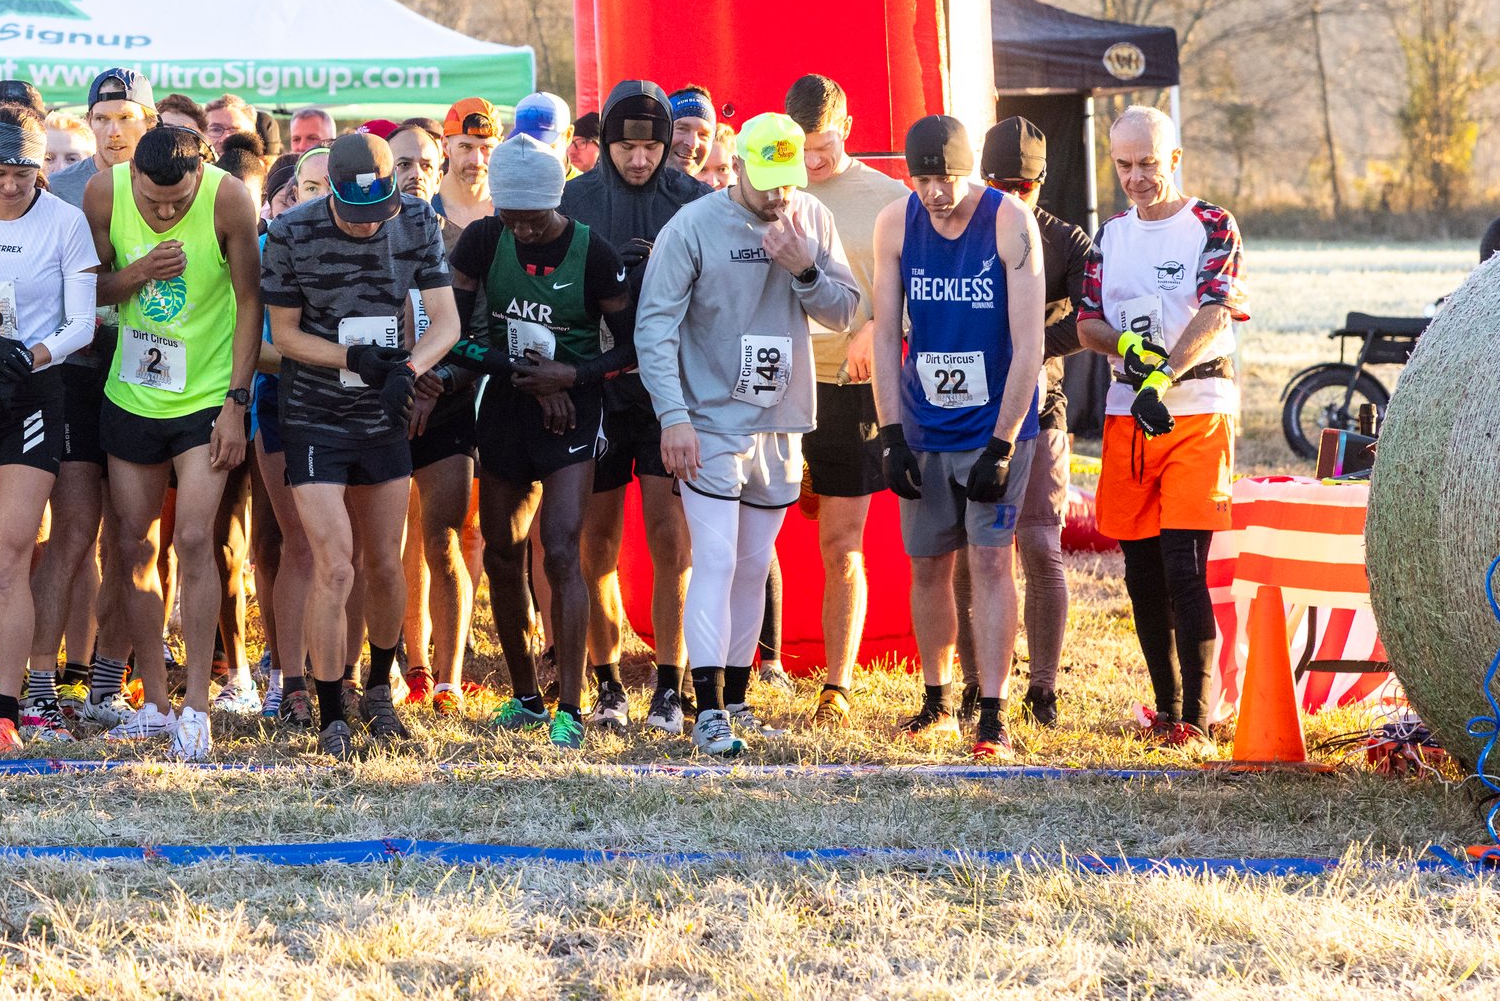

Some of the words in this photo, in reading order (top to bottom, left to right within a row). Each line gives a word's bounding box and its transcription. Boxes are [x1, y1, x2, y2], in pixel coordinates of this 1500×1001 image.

[911, 268, 925, 276] TEAM
[910, 277, 994, 302] RECKLESS
[506, 297, 553, 324] AKR
[132, 329, 149, 342] Dirt
[151, 333, 179, 349] Circus
[385, 327, 396, 346] Dirt
[510, 327, 518, 356] Circus
[147, 347, 162, 375] 2
[741, 344, 753, 376] Circus
[753, 347, 781, 395] 148
[926, 353, 941, 364] Dirt
[943, 354, 975, 364] Circus
[736, 377, 750, 394] Dirt
[934, 369, 968, 395] 22
